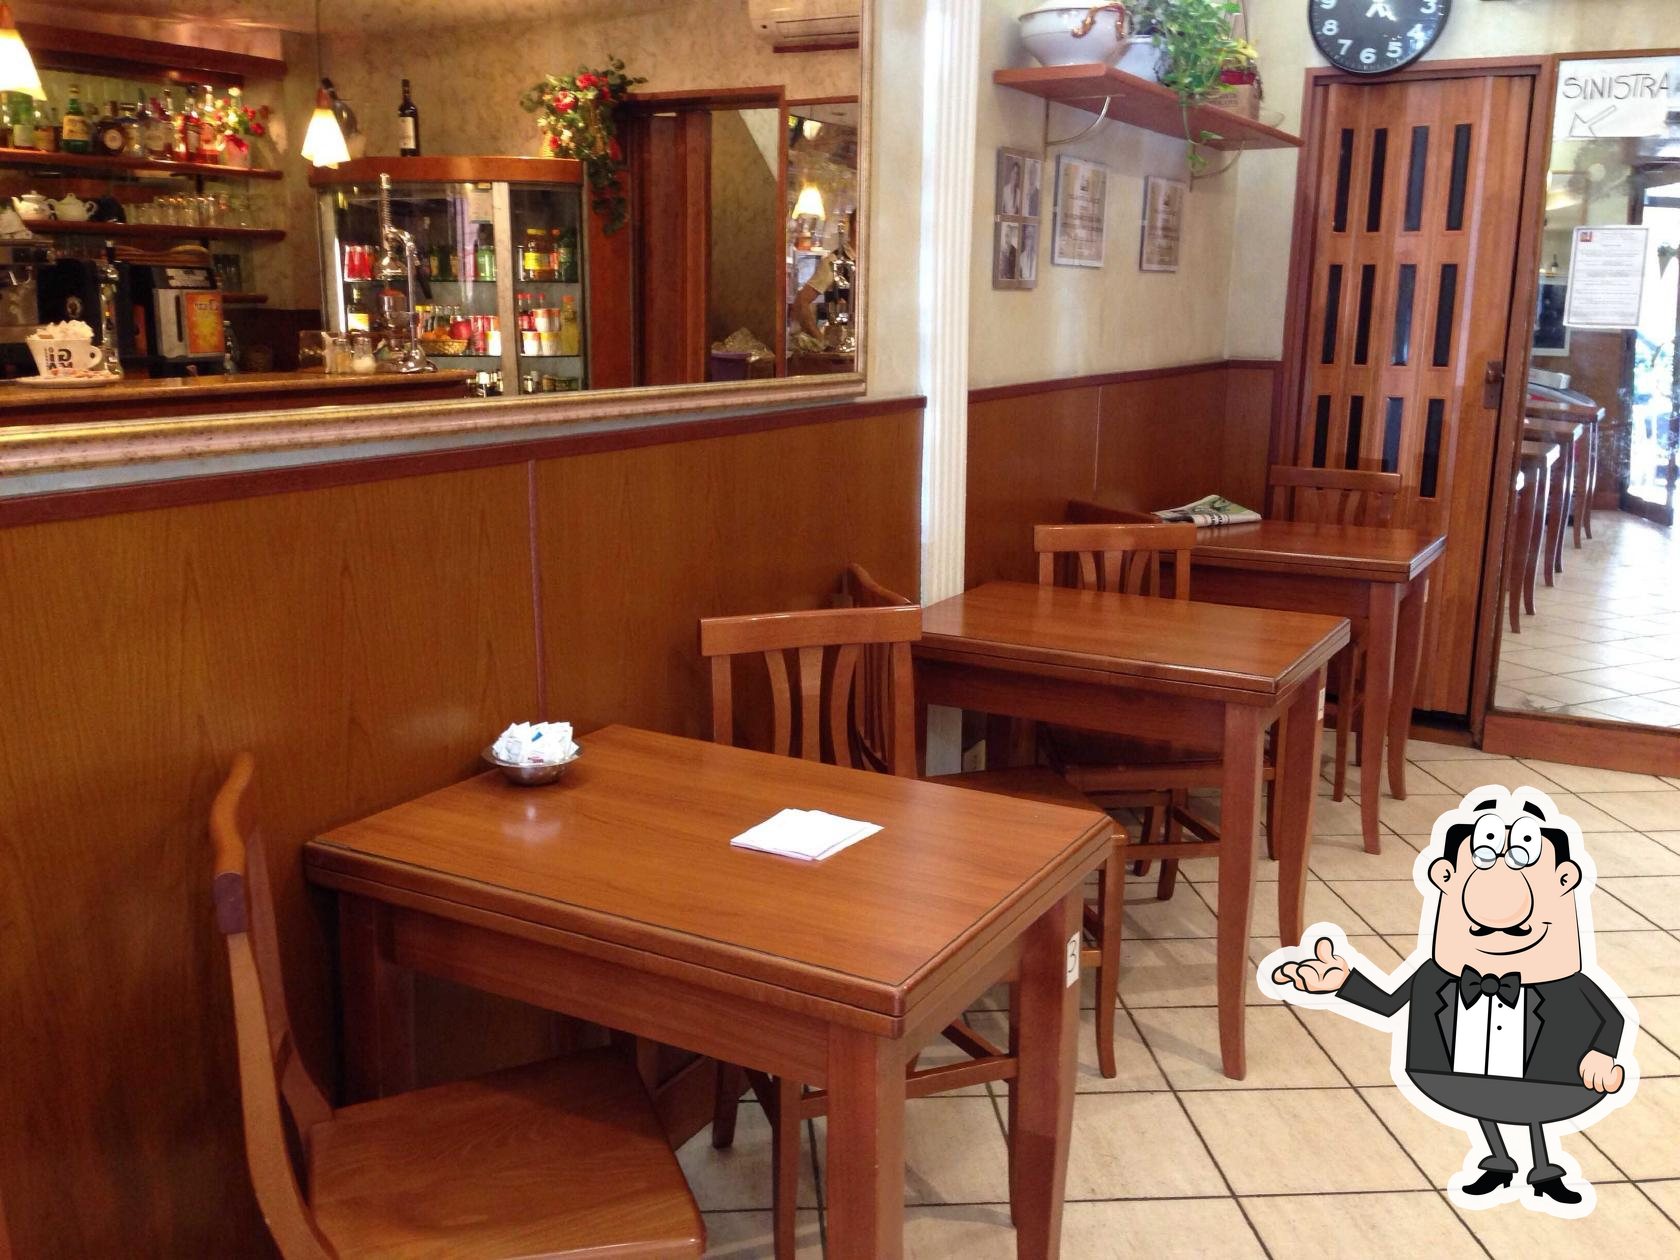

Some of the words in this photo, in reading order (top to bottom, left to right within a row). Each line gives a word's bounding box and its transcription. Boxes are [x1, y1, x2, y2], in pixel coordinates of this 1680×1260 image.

[1420, 0, 1436, 13] 3
[1322, 20, 1338, 35] 8
[1406, 24, 1425, 40] 4
[1337, 39, 1352, 55] 7
[1386, 42, 1402, 57] 5
[1360, 48, 1376, 63] 6
[1562, 72, 1669, 100] SINISTRA
